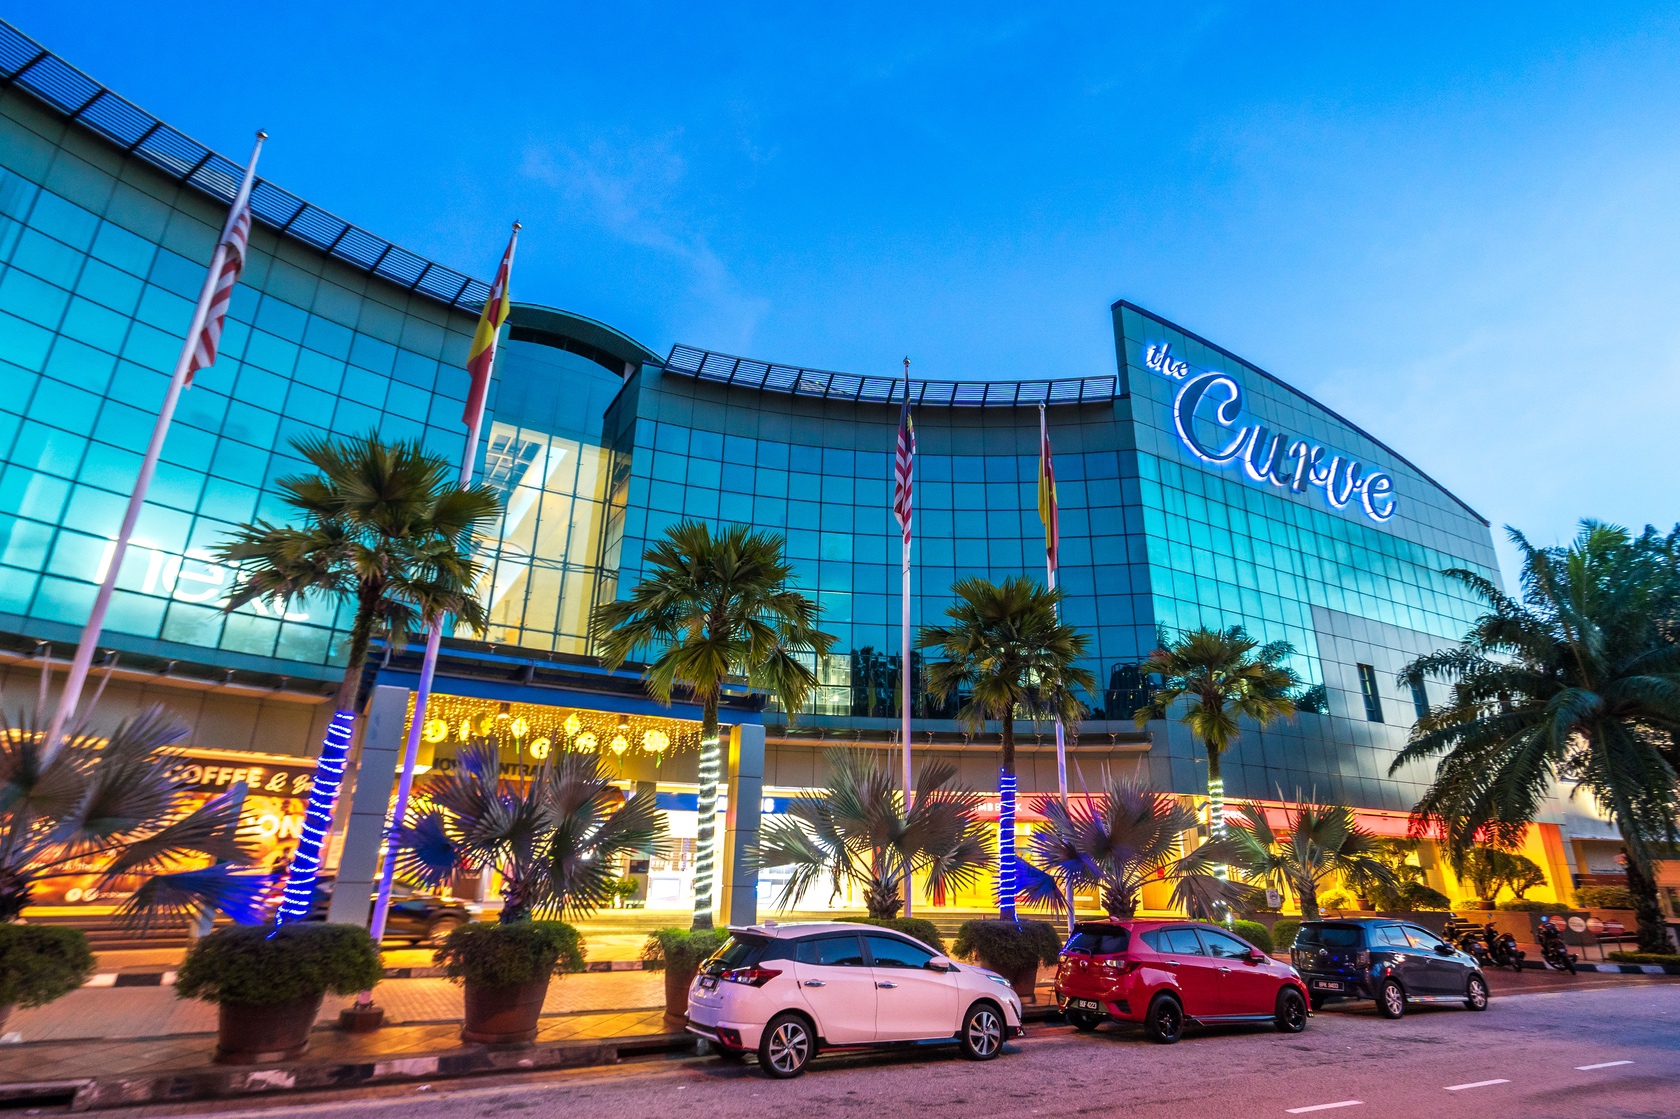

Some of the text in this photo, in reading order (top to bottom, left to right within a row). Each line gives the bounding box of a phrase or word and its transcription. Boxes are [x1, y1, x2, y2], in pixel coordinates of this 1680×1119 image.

[1146, 342, 1190, 379] the
[1173, 371, 1398, 523] Curve
[264, 772, 288, 793] &
